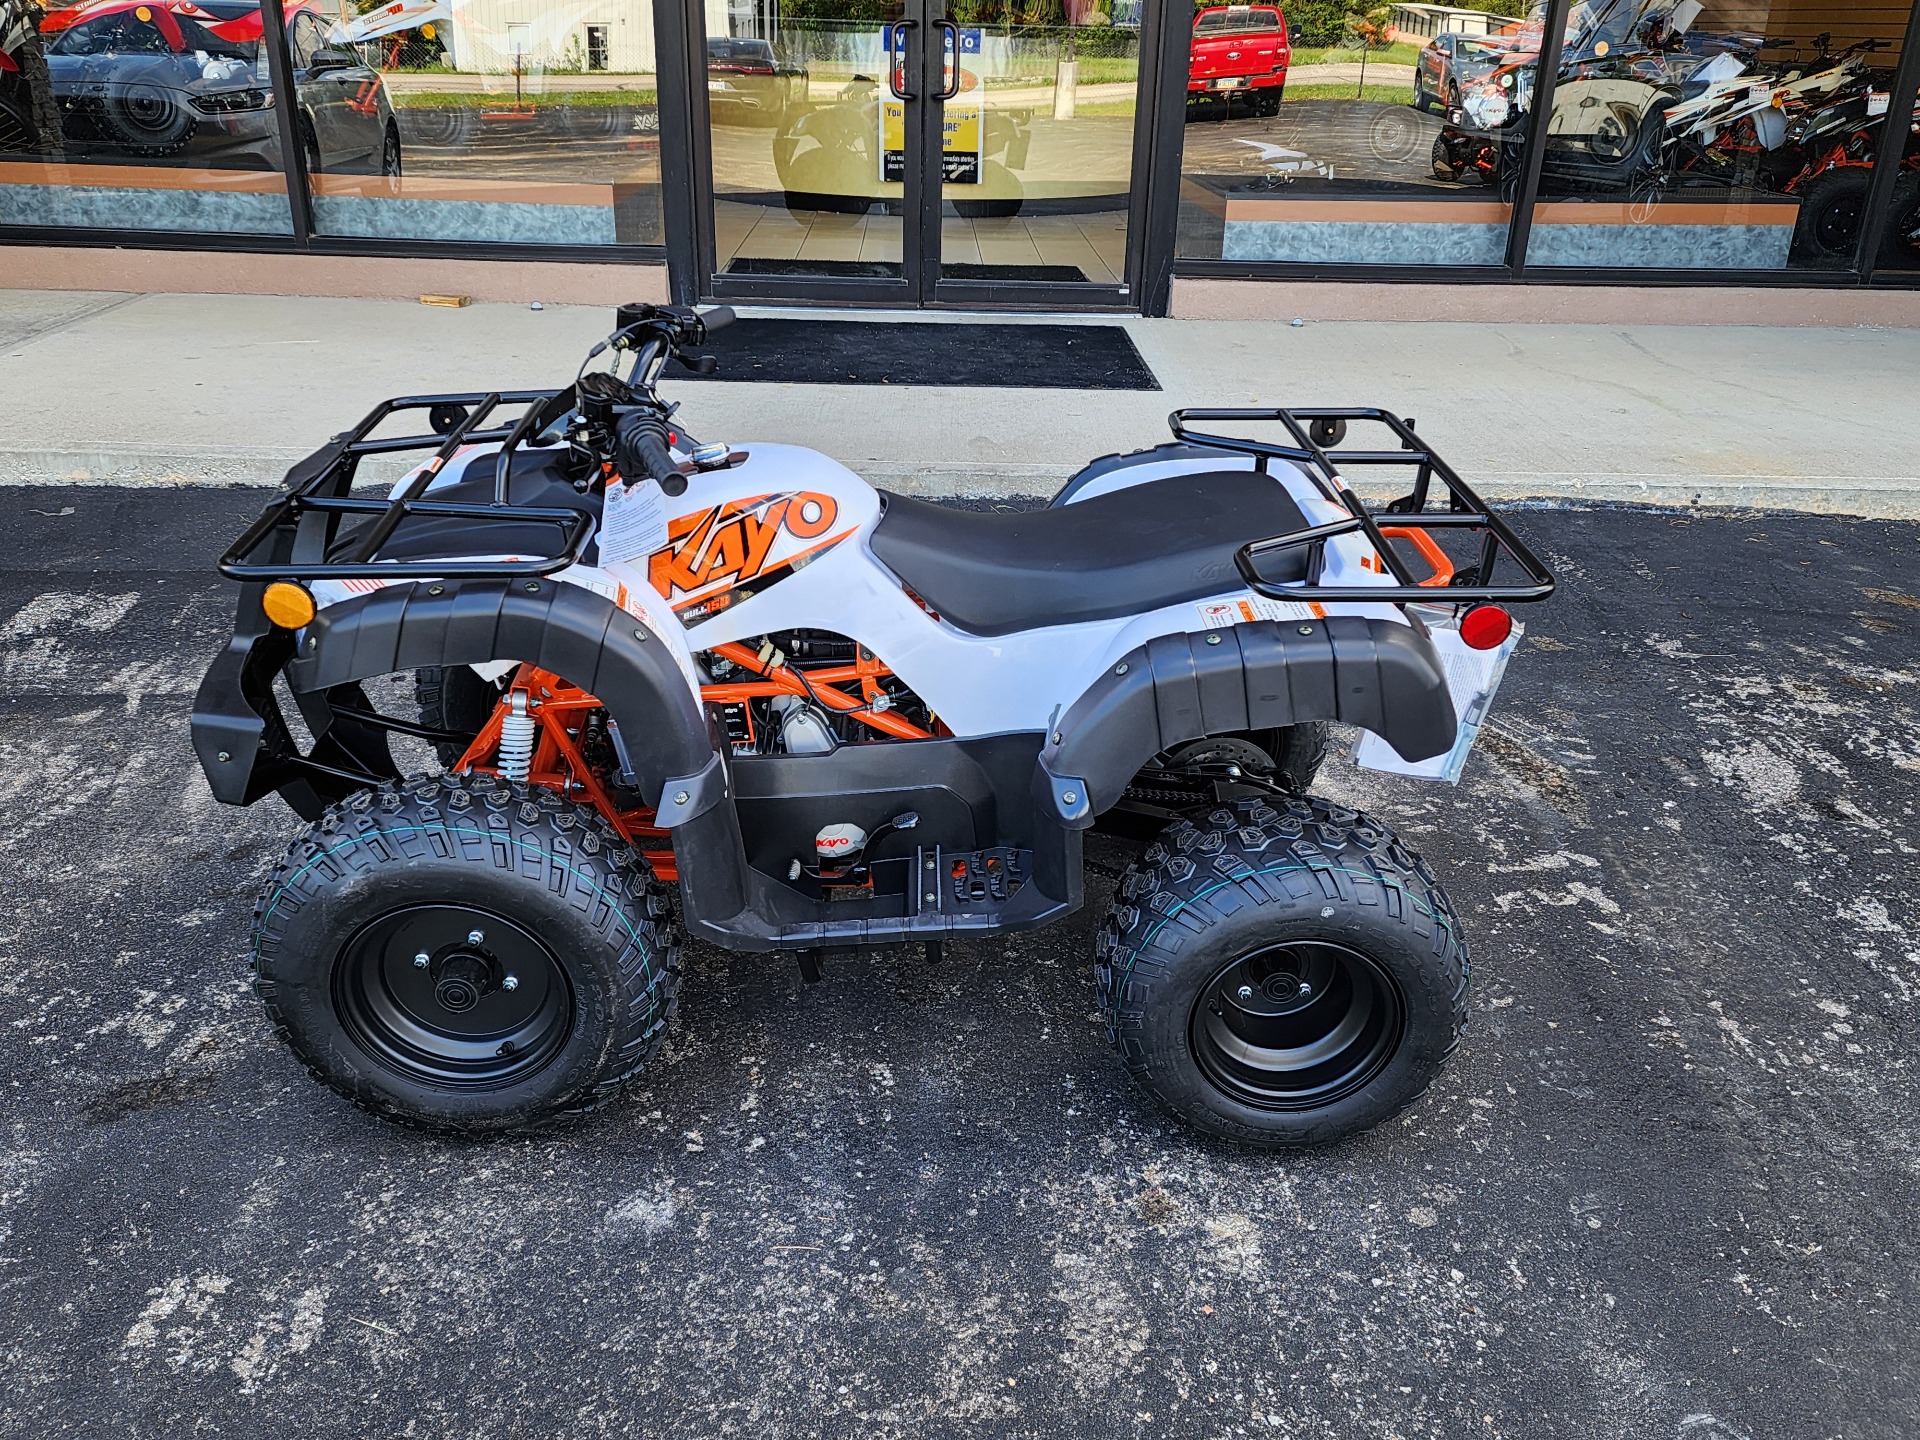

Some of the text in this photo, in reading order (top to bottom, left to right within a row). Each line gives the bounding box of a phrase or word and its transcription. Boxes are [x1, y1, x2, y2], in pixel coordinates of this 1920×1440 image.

[886, 107, 901, 117] You
[648, 489, 840, 602] KAYO
[816, 837, 849, 848] KAYO
